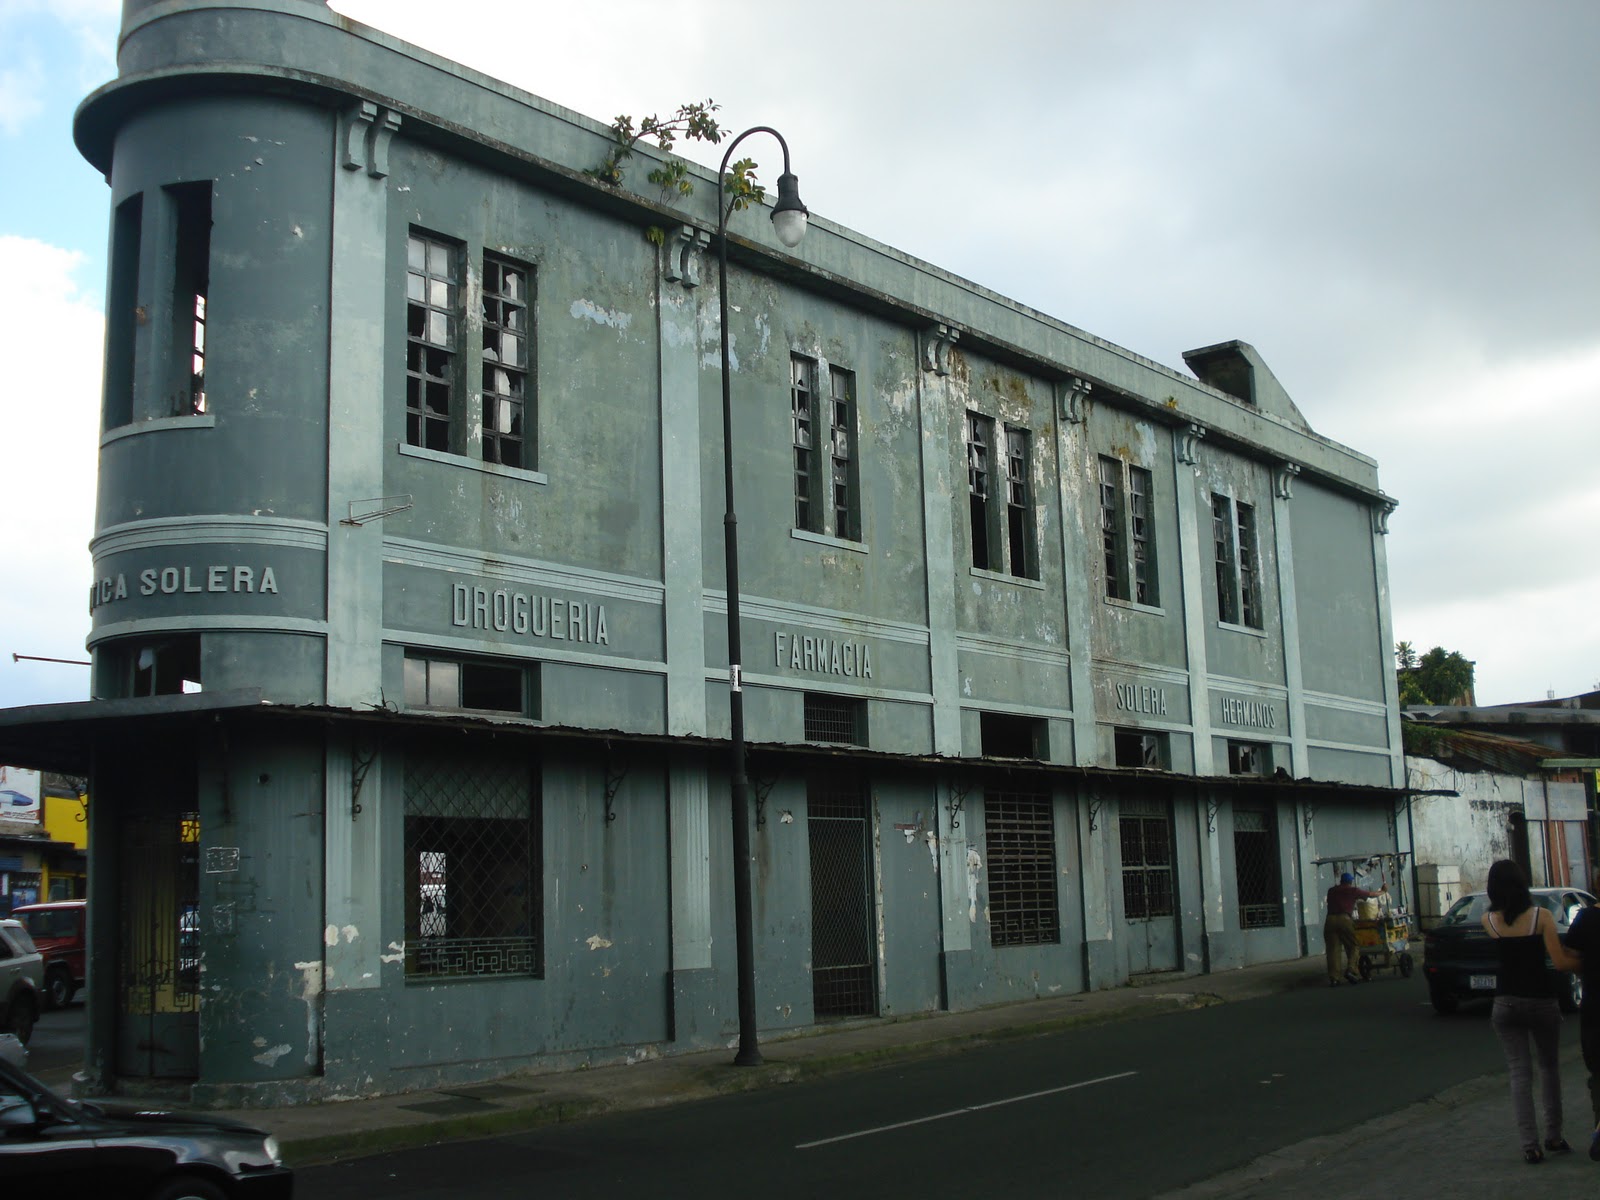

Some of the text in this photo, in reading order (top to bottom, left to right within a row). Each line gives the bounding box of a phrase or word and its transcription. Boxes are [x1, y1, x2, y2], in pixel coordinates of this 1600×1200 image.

[140, 566, 278, 595] SOLERA
[453, 584, 608, 645] DROGUERIA
[775, 631, 872, 679] FARMACIA
[1116, 682, 1167, 716] SOLERA
[1222, 698, 1276, 728] HERMANOS
